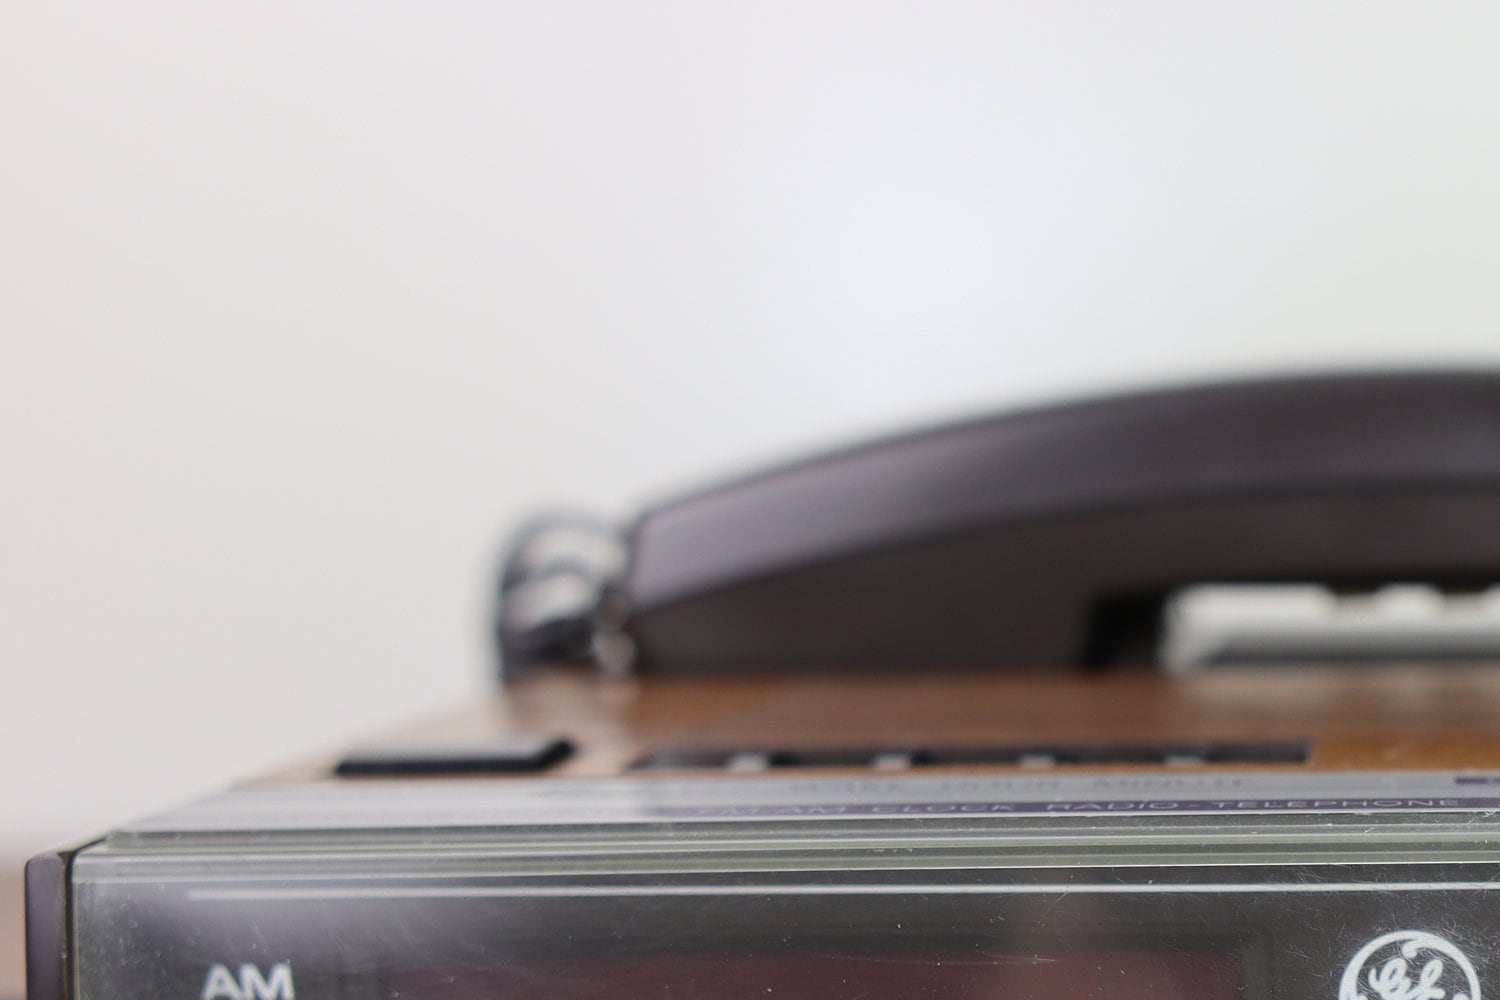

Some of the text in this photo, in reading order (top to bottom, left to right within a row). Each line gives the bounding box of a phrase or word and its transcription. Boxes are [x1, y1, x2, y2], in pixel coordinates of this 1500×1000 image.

[872, 804, 1014, 813] CLOCK
[1046, 802, 1178, 810] RADIO
[1211, 799, 1459, 808] TELEPHONE
